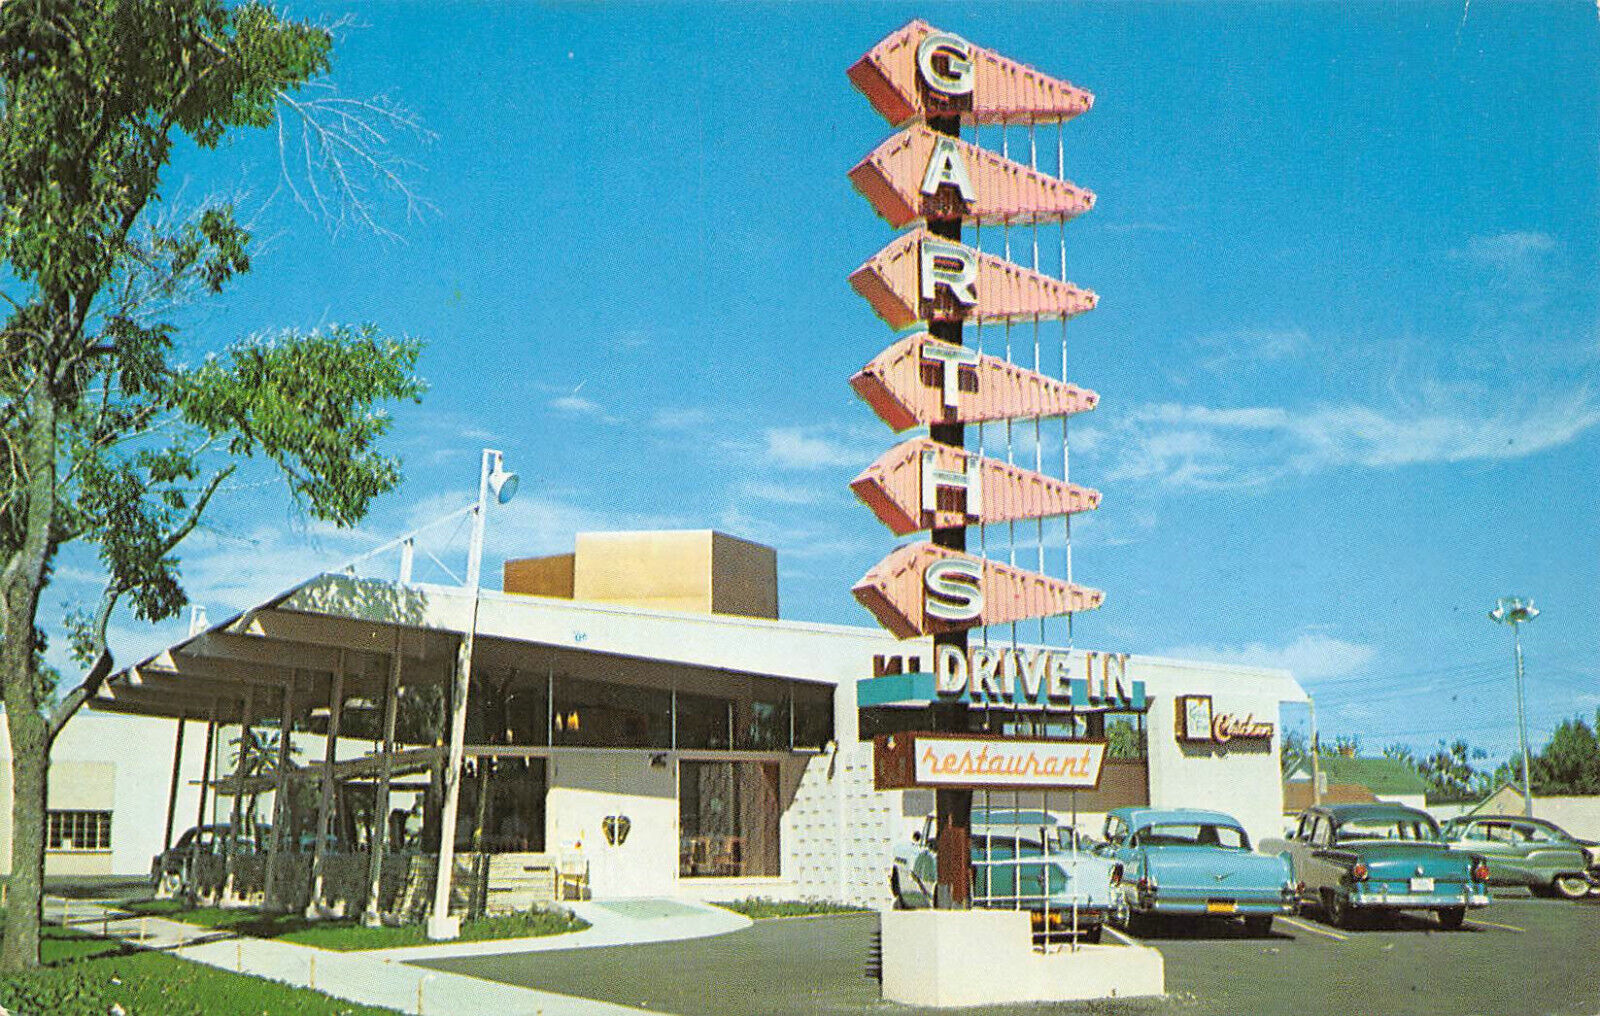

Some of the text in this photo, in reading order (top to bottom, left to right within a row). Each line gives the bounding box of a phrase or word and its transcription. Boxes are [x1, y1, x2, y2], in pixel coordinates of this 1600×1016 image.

[916, 32, 985, 622] GARTHS
[934, 644, 1073, 703] DRIVE
[1086, 651, 1135, 706] IN
[921, 743, 1092, 778] restaurant
